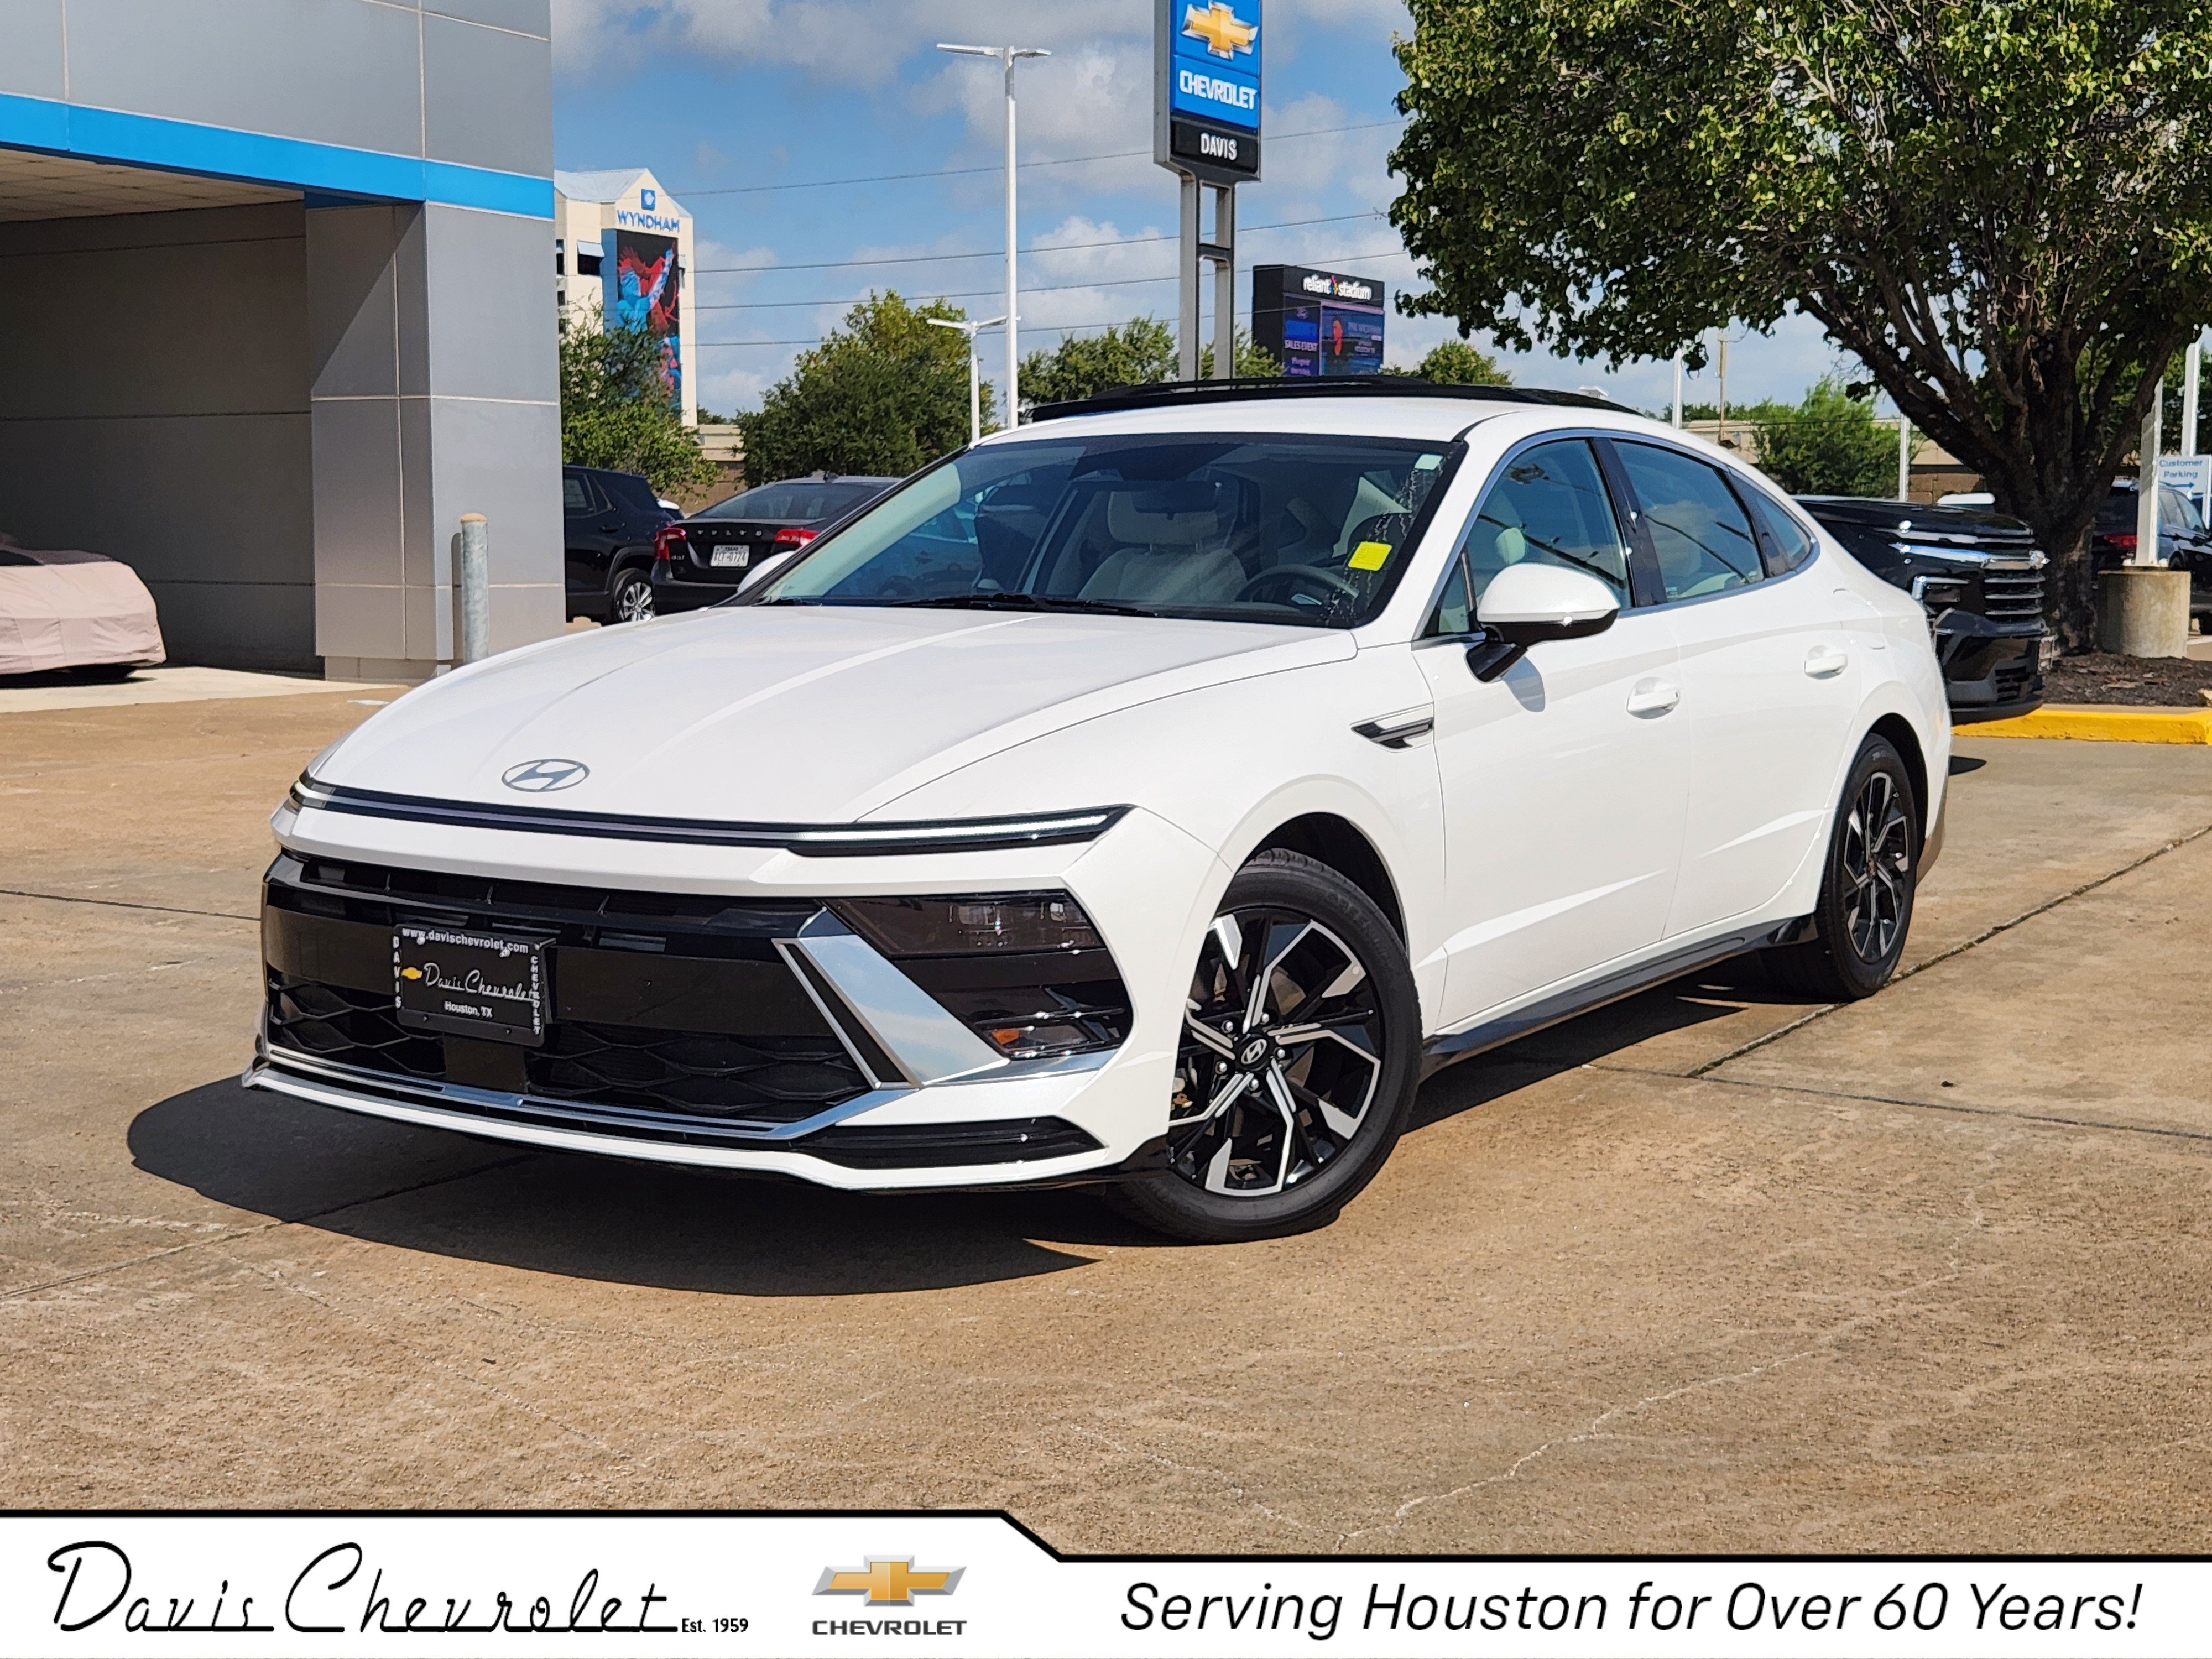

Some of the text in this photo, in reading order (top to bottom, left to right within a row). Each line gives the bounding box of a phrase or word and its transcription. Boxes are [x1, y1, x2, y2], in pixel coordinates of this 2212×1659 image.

[1180, 70, 1258, 110] CHEVROLET
[1201, 132, 1238, 161] DAVIS
[618, 210, 680, 233] WYNDHAM
[1303, 274, 1372, 300] reliant stadium
[2164, 471, 2198, 479] Parking
[402, 928, 529, 954] www.davischevrolet.com
[393, 936, 402, 1009] DAVIS
[424, 962, 535, 1002] Davis Chevrolet
[530, 956, 541, 1035] CHEVROLET
[444, 1001, 493, 1018] Houston, TX
